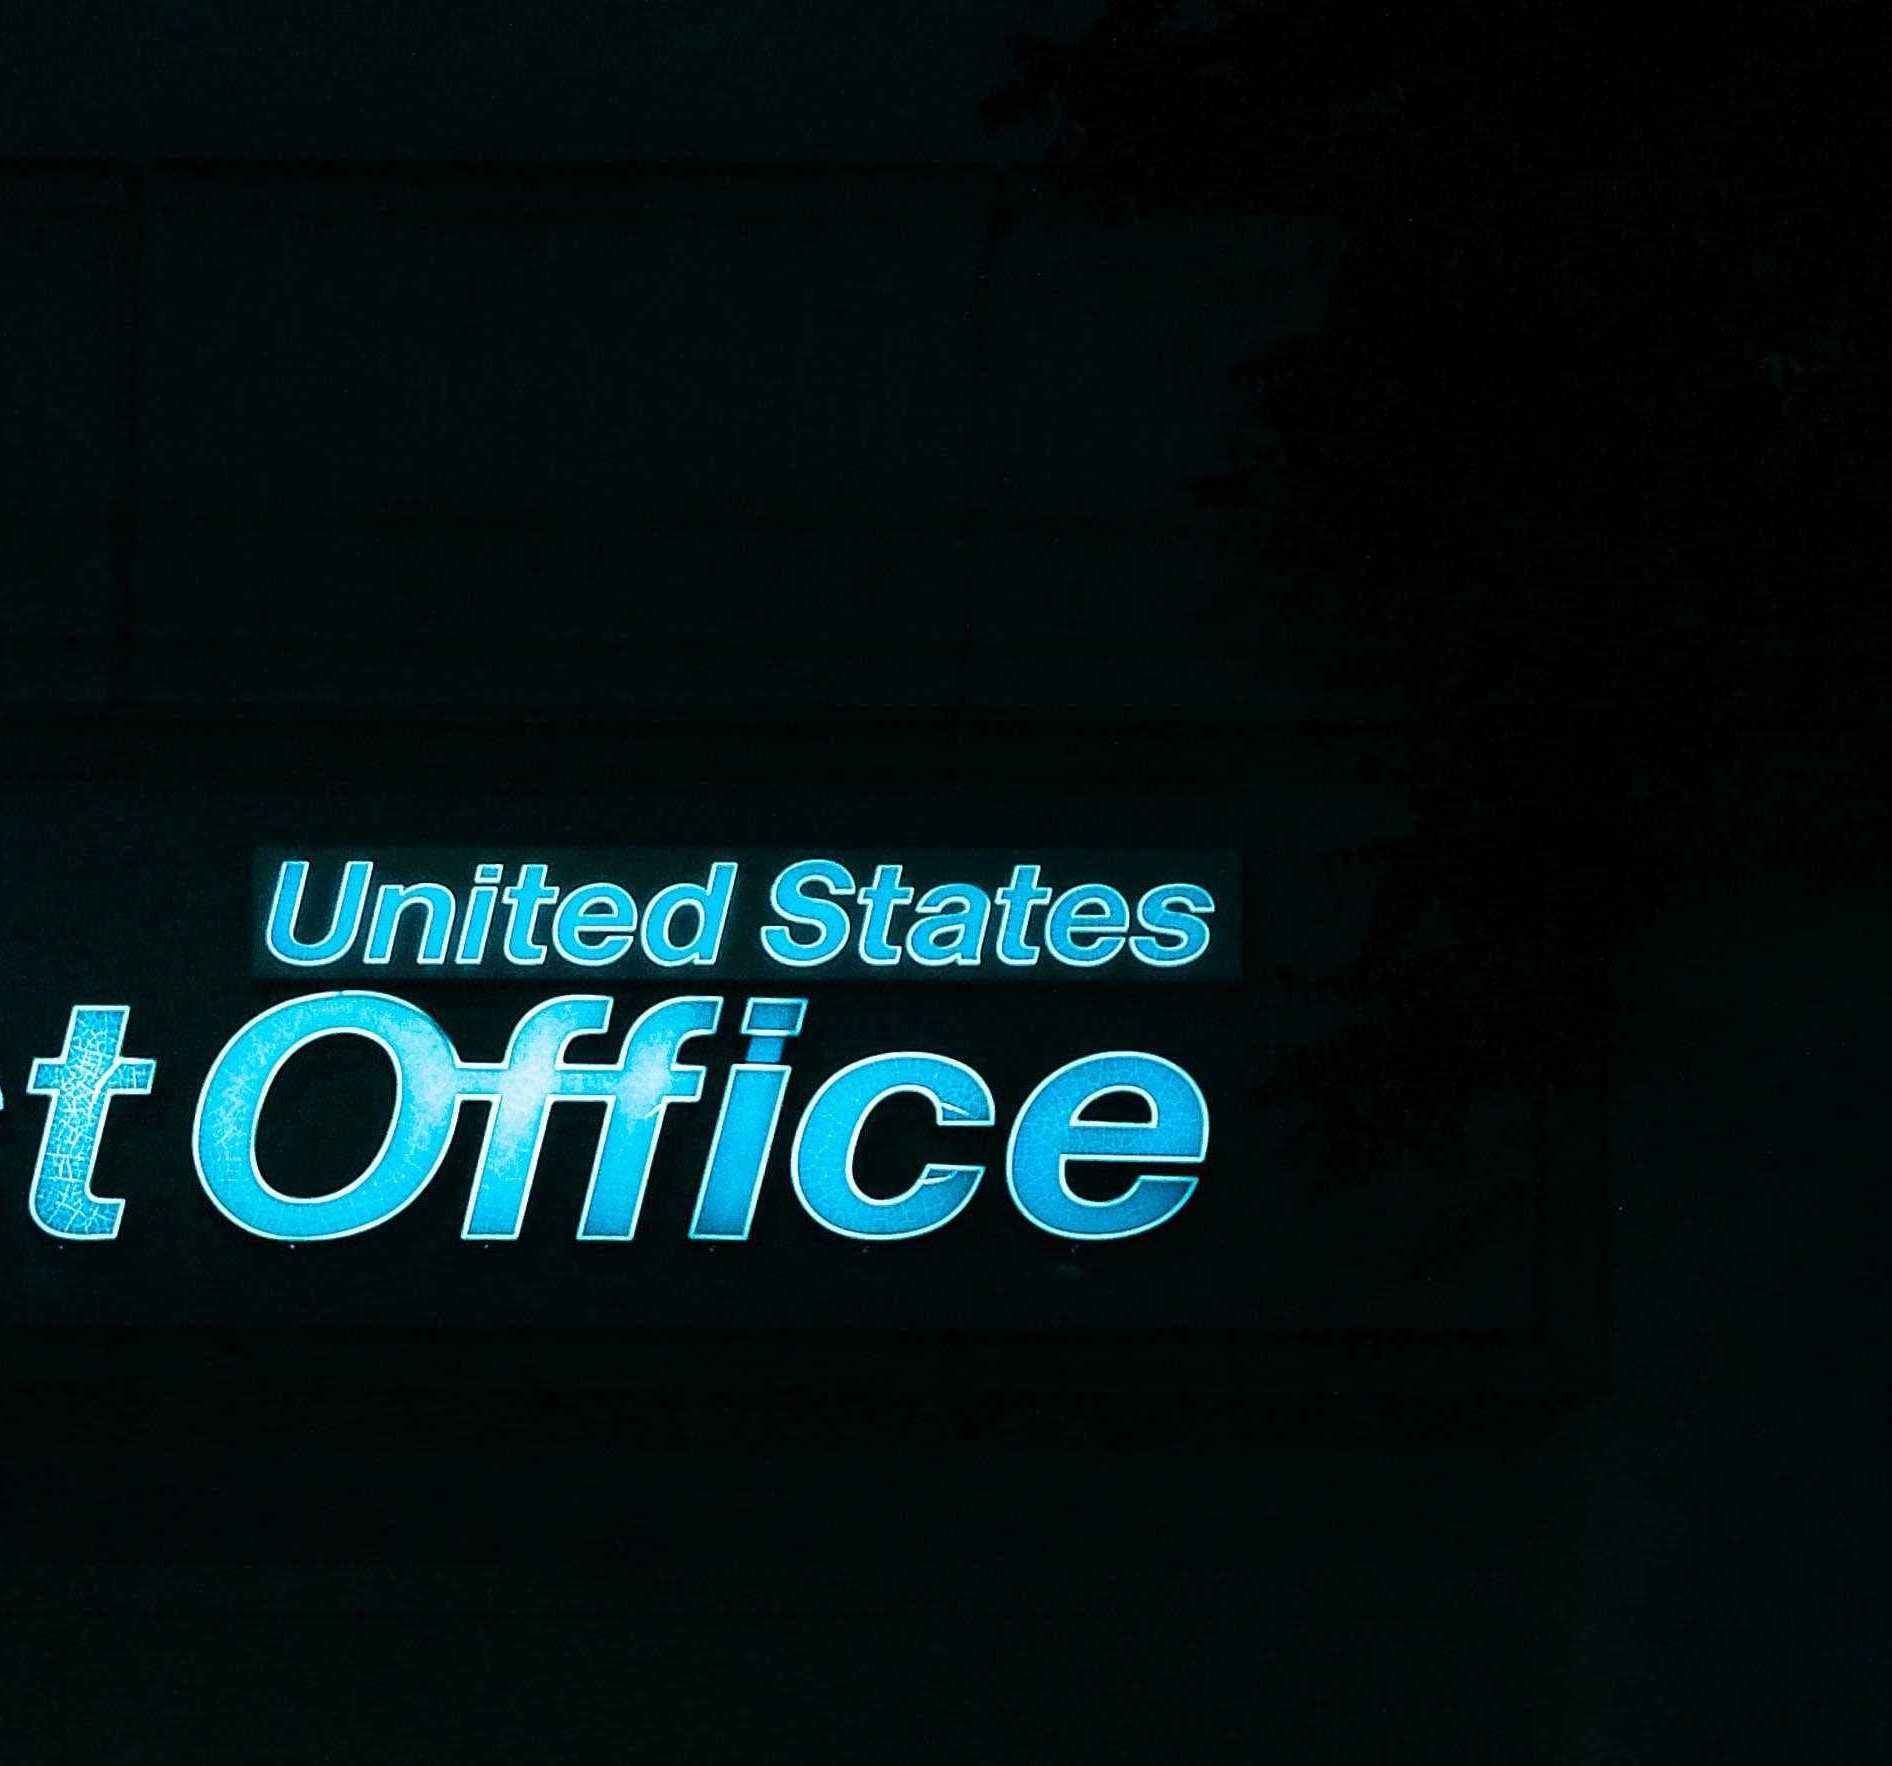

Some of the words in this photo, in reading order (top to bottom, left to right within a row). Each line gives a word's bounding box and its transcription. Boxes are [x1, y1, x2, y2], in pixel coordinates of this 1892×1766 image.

[265, 860, 738, 968] United
[760, 858, 1215, 968] States
[191, 989, 1210, 1242] Office
